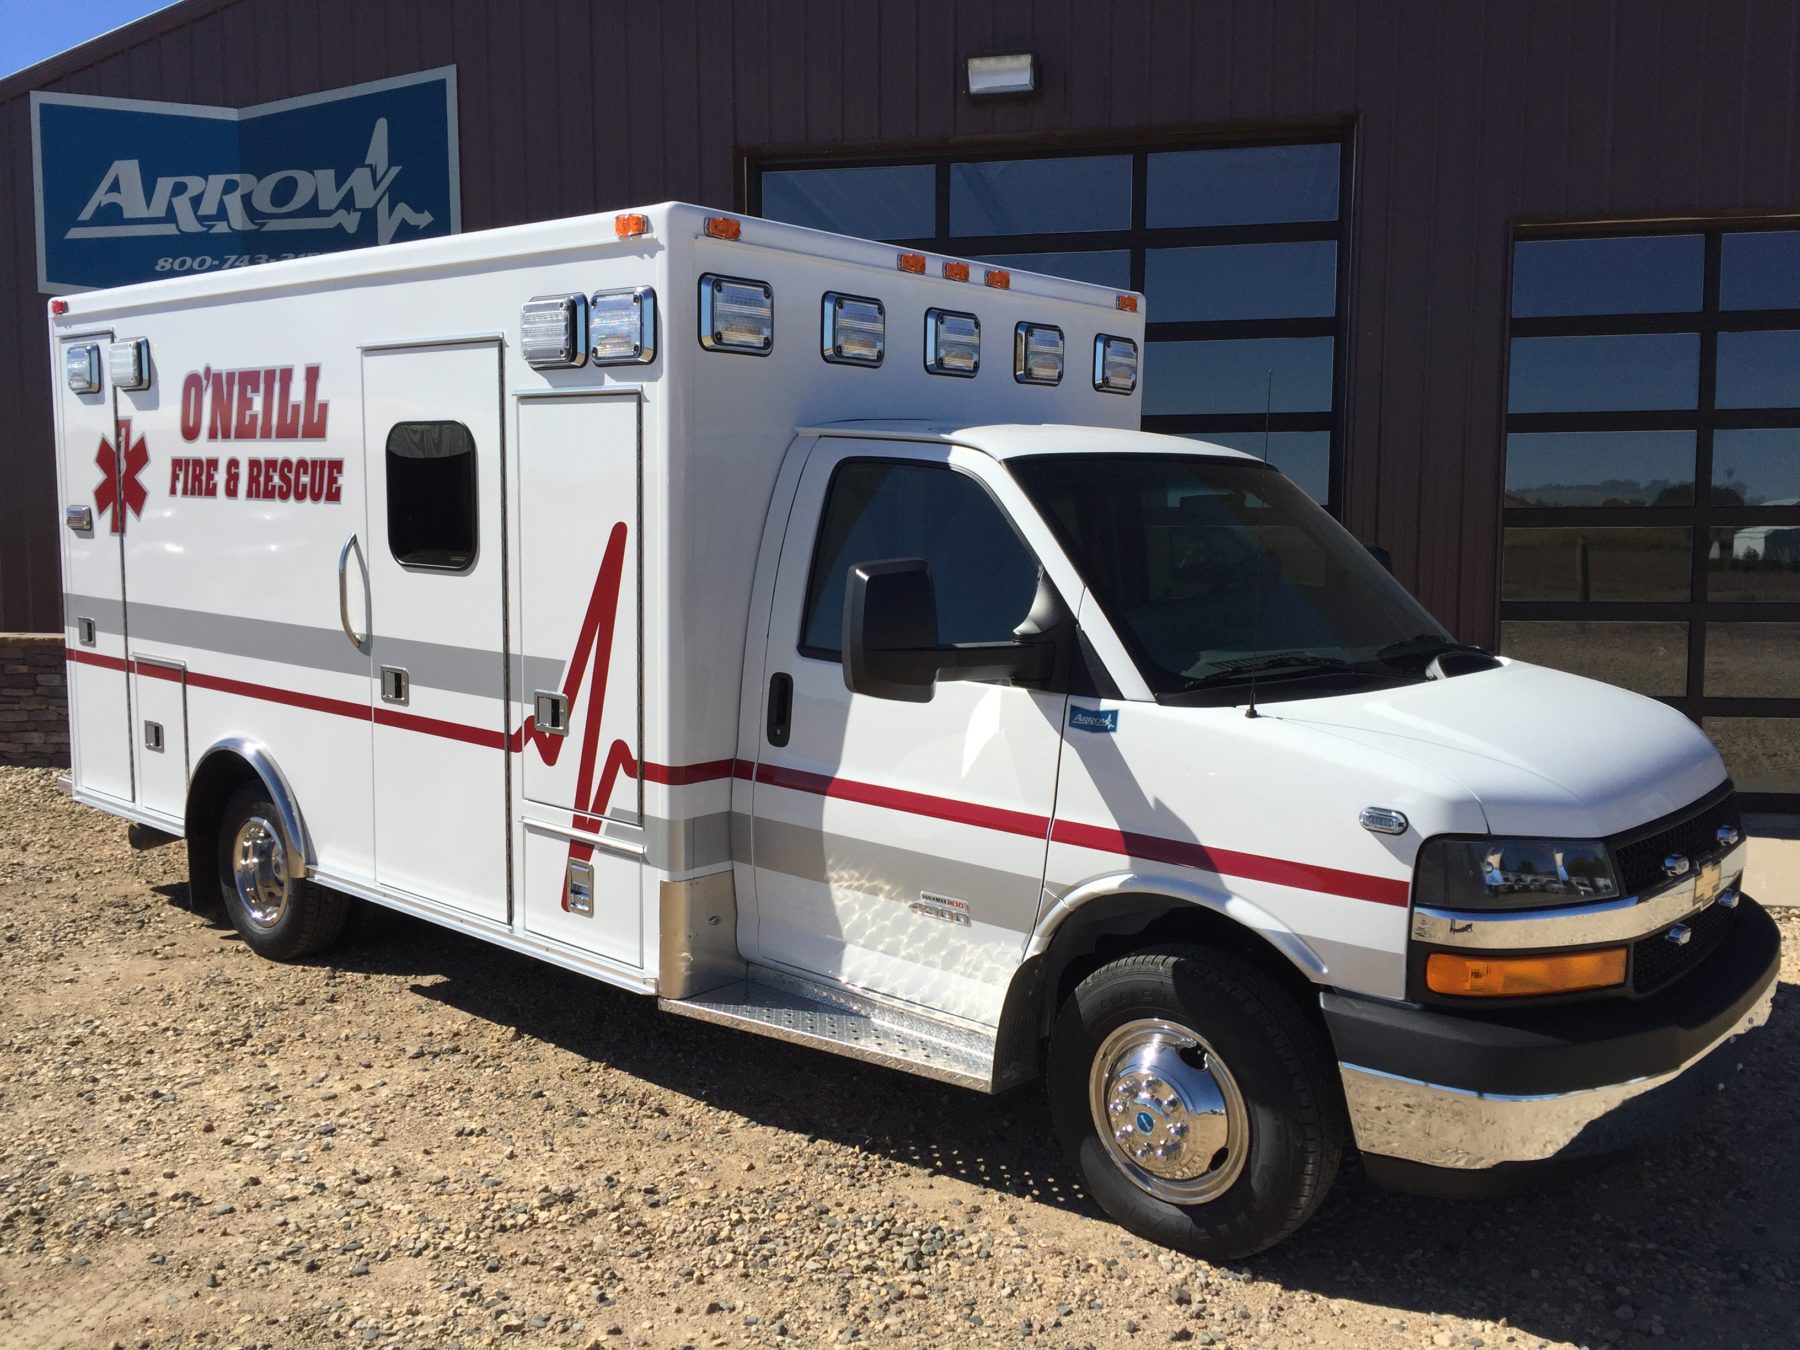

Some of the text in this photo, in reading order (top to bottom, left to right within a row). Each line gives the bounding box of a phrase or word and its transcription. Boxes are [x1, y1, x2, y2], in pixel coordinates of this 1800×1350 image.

[77, 157, 402, 233] ARROW
[155, 252, 329, 271] 800-743-
[181, 363, 330, 443] O'NEILL
[169, 456, 344, 504] FIRE & RESCUE
